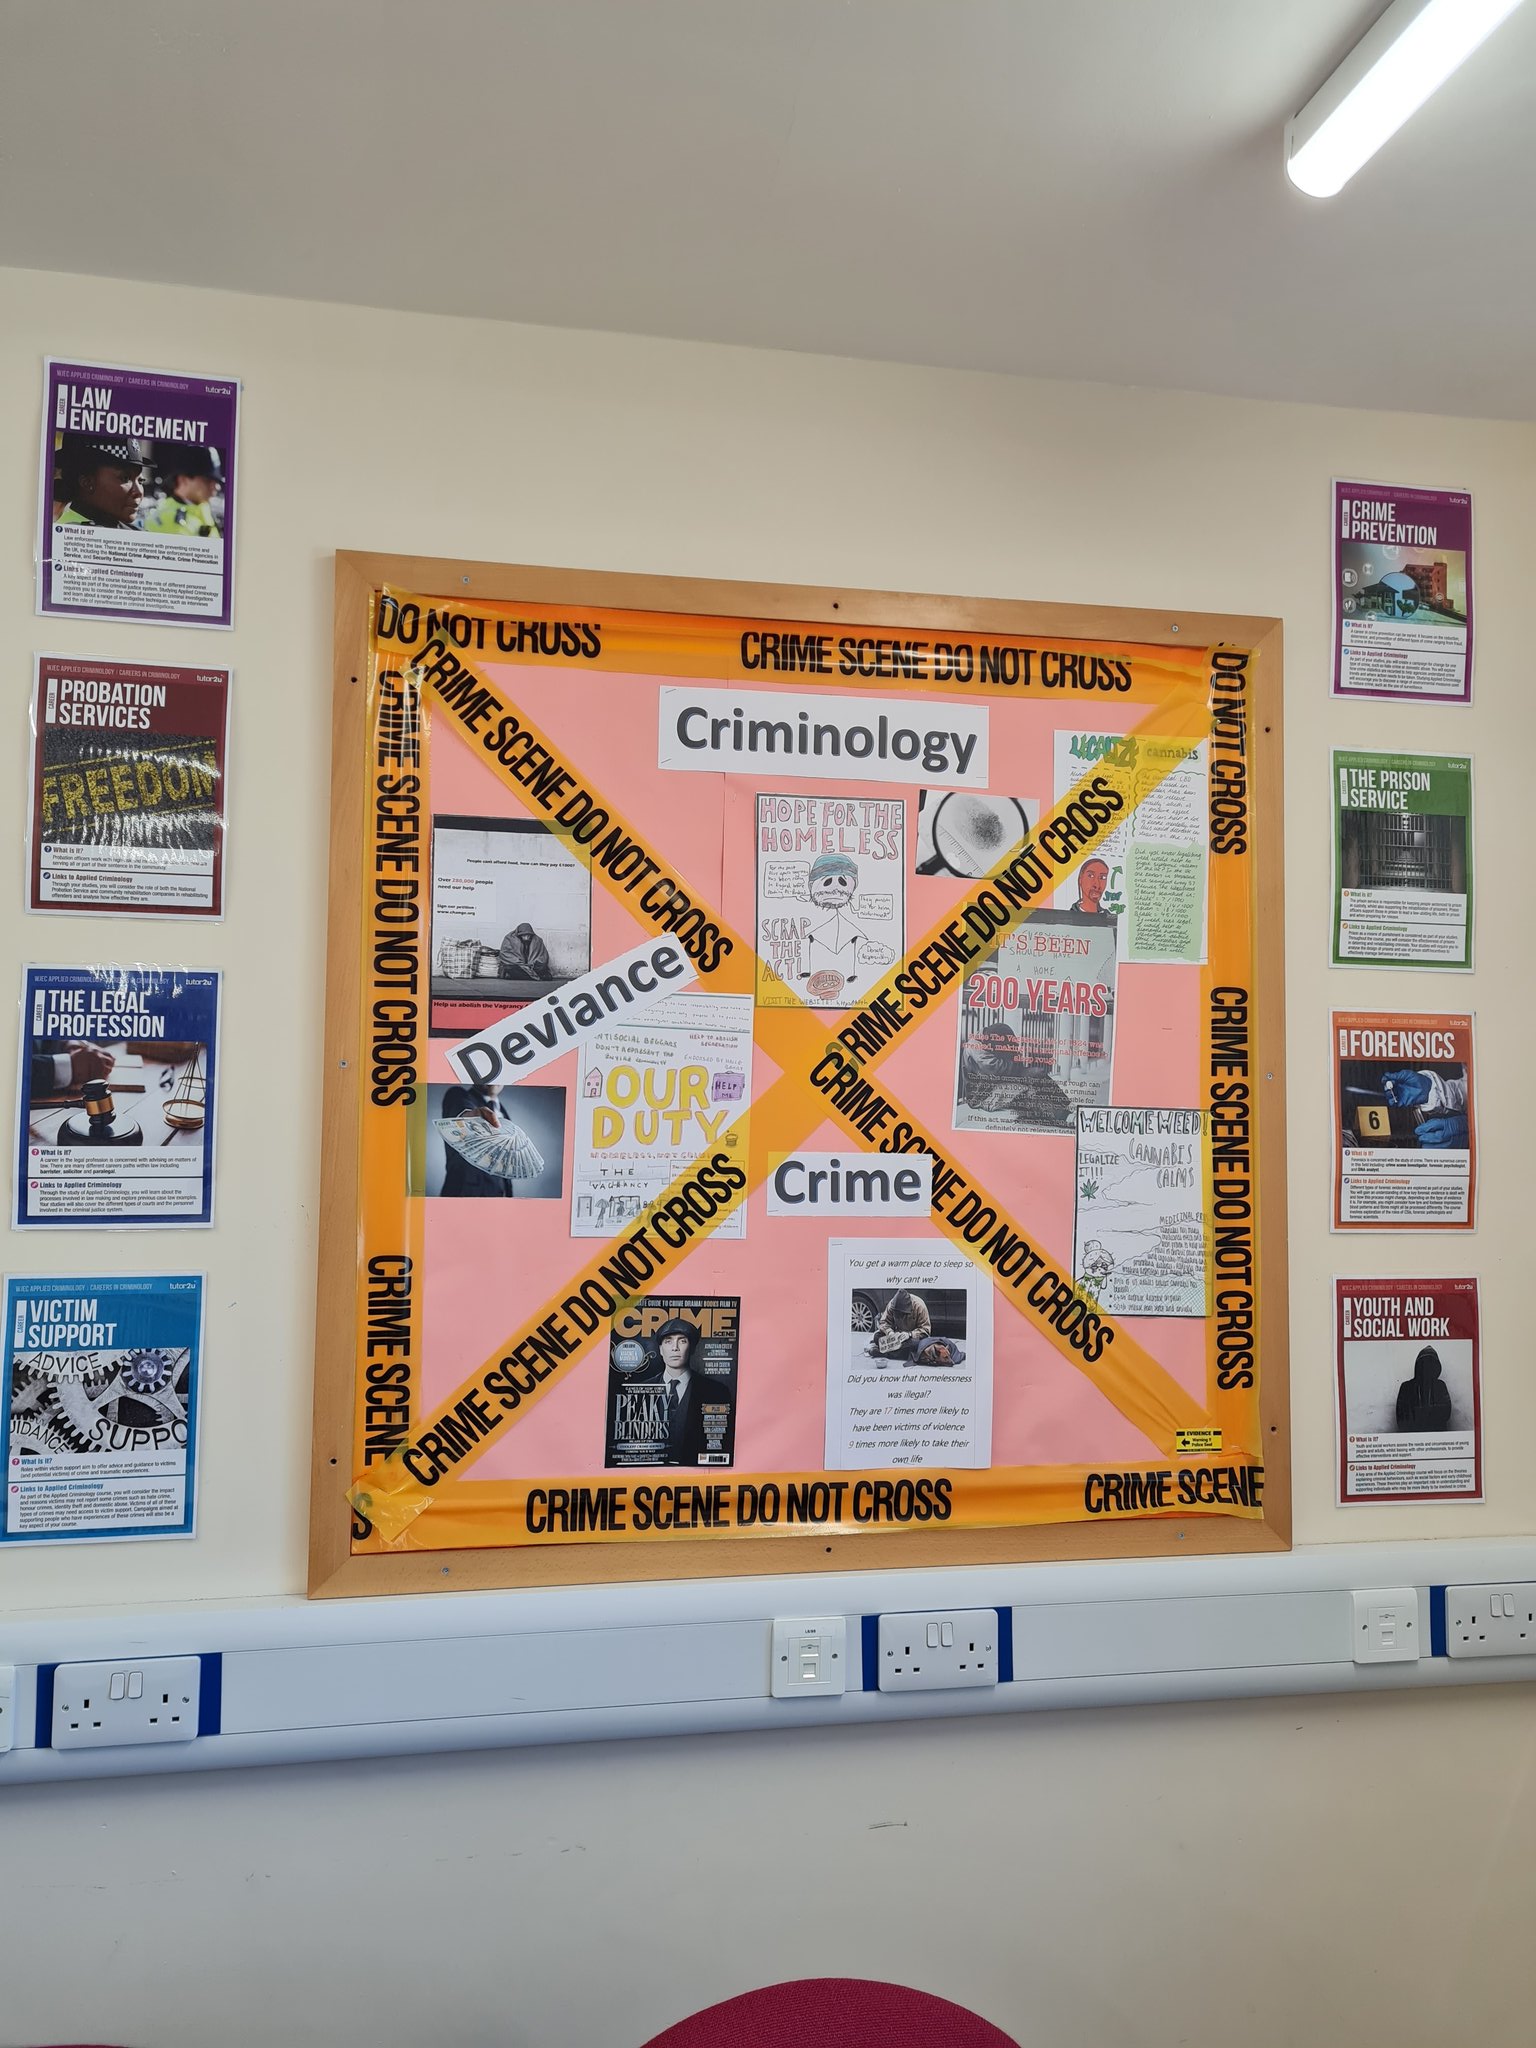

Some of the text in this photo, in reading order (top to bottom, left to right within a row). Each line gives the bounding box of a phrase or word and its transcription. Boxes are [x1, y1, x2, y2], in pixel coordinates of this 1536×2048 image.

[71, 385, 112, 410] LAW
[70, 408, 208, 443] ENFORCEMENT
[1352, 500, 1396, 523] CRIME
[1351, 521, 1437, 546] PREVENTION
[377, 594, 601, 659] DO NOT CROSS
[741, 631, 1132, 692] CRIME SCENE DO NOT CROSS
[61, 679, 166, 707] PROBATION
[59, 703, 151, 730] SERVICES
[676, 706, 977, 774] Criminology
[1146, 747, 1199, 760] cannabis
[1210, 652, 1249, 855] DO NOT CROSS
[1349, 768, 1431, 792] THE PRISON
[411, 640, 504, 734] CRIME
[484, 716, 577, 811] SCENE
[555, 791, 610, 845] DO
[590, 827, 661, 893] NOT
[641, 878, 733, 973] CROSS
[1350, 789, 1409, 810] SERVICE
[760, 798, 902, 831] HOPE FOR THE
[761, 827, 899, 860] HOMELESS
[371, 670, 420, 1107] CRIME SCENE DO NOT CROSS
[762, 917, 812, 941] SCRAP
[825, 988, 914, 1078] CRIME
[894, 920, 982, 1009] SCENE
[961, 892, 1011, 944] DO
[993, 843, 1053, 911] NOT
[1039, 778, 1124, 865] CROSS
[770, 941, 802, 959] THE
[990, 932, 1092, 955] IT'S BEEN
[762, 958, 802, 982] ACT!
[48, 990, 150, 1014] THE LEGAL
[968, 973, 1108, 1017] 200 YEARS
[47, 1014, 165, 1038] PROFESSION
[457, 946, 684, 1084] Deviance
[1351, 1030, 1455, 1059] FORENSICS
[606, 1064, 710, 1110] OUR
[715, 1080, 738, 1091] HELP
[592, 1106, 730, 1149] DUTY
[1080, 1110, 1208, 1136] WELCOME WEED!
[1369, 1110, 1380, 1130] 6
[1129, 1138, 1193, 1166] CANNABIS
[600, 1168, 635, 1177] THE
[774, 1159, 923, 1206] Crime
[1156, 1167, 1194, 1188] CALMS
[592, 1181, 649, 1190] VAGRANCY
[1210, 986, 1254, 1390] CRIME SCENE DO NOT CROSS
[809, 1052, 898, 1143] CRIME
[946, 1191, 997, 1243] DO
[980, 1224, 1046, 1289] NOT
[1028, 1272, 1115, 1363] CROSS
[850, 1259, 864, 1268] You
[866, 1260, 879, 1269] get
[910, 1259, 931, 1269] place
[933, 1260, 942, 1268] to
[943, 1259, 963, 1270] sleep
[886, 1276, 938, 1286] why cant we?
[30, 1299, 97, 1322] VICTIM
[1353, 1296, 1434, 1317] YOUTH AND
[403, 1389, 504, 1487] CRIME
[484, 1313, 582, 1410] SCENE
[561, 1279, 617, 1336] DO
[599, 1227, 666, 1300] NOT
[651, 1153, 747, 1249] CROSS
[1353, 1317, 1450, 1338] SOCIAL WORK
[28, 1323, 117, 1348] SUPPORT
[29, 1351, 102, 1373] ADVICE
[364, 1255, 413, 1466] CRIME SCENE
[847, 1374, 972, 1385] Did you know that homelessness
[615, 1393, 674, 1422] PEAKY
[904, 1390, 932, 1400] illegal?
[850, 1408, 868, 1417] They
[894, 1407, 914, 1415] times
[939, 1406, 960, 1417] likely
[613, 1421, 670, 1440] BLINDERS
[852, 1422, 965, 1432] have been victims of violence
[855, 1440, 876, 1448] times
[878, 1440, 898, 1448] more
[900, 1439, 920, 1449] likely
[932, 1439, 949, 1447] take
[950, 1439, 970, 1448] their
[892, 1454, 923, 1464] own life
[1084, 1466, 1265, 1514] CRIME SCENE
[526, 1478, 953, 1534] CRIME SCENE DO NOT CROSS
